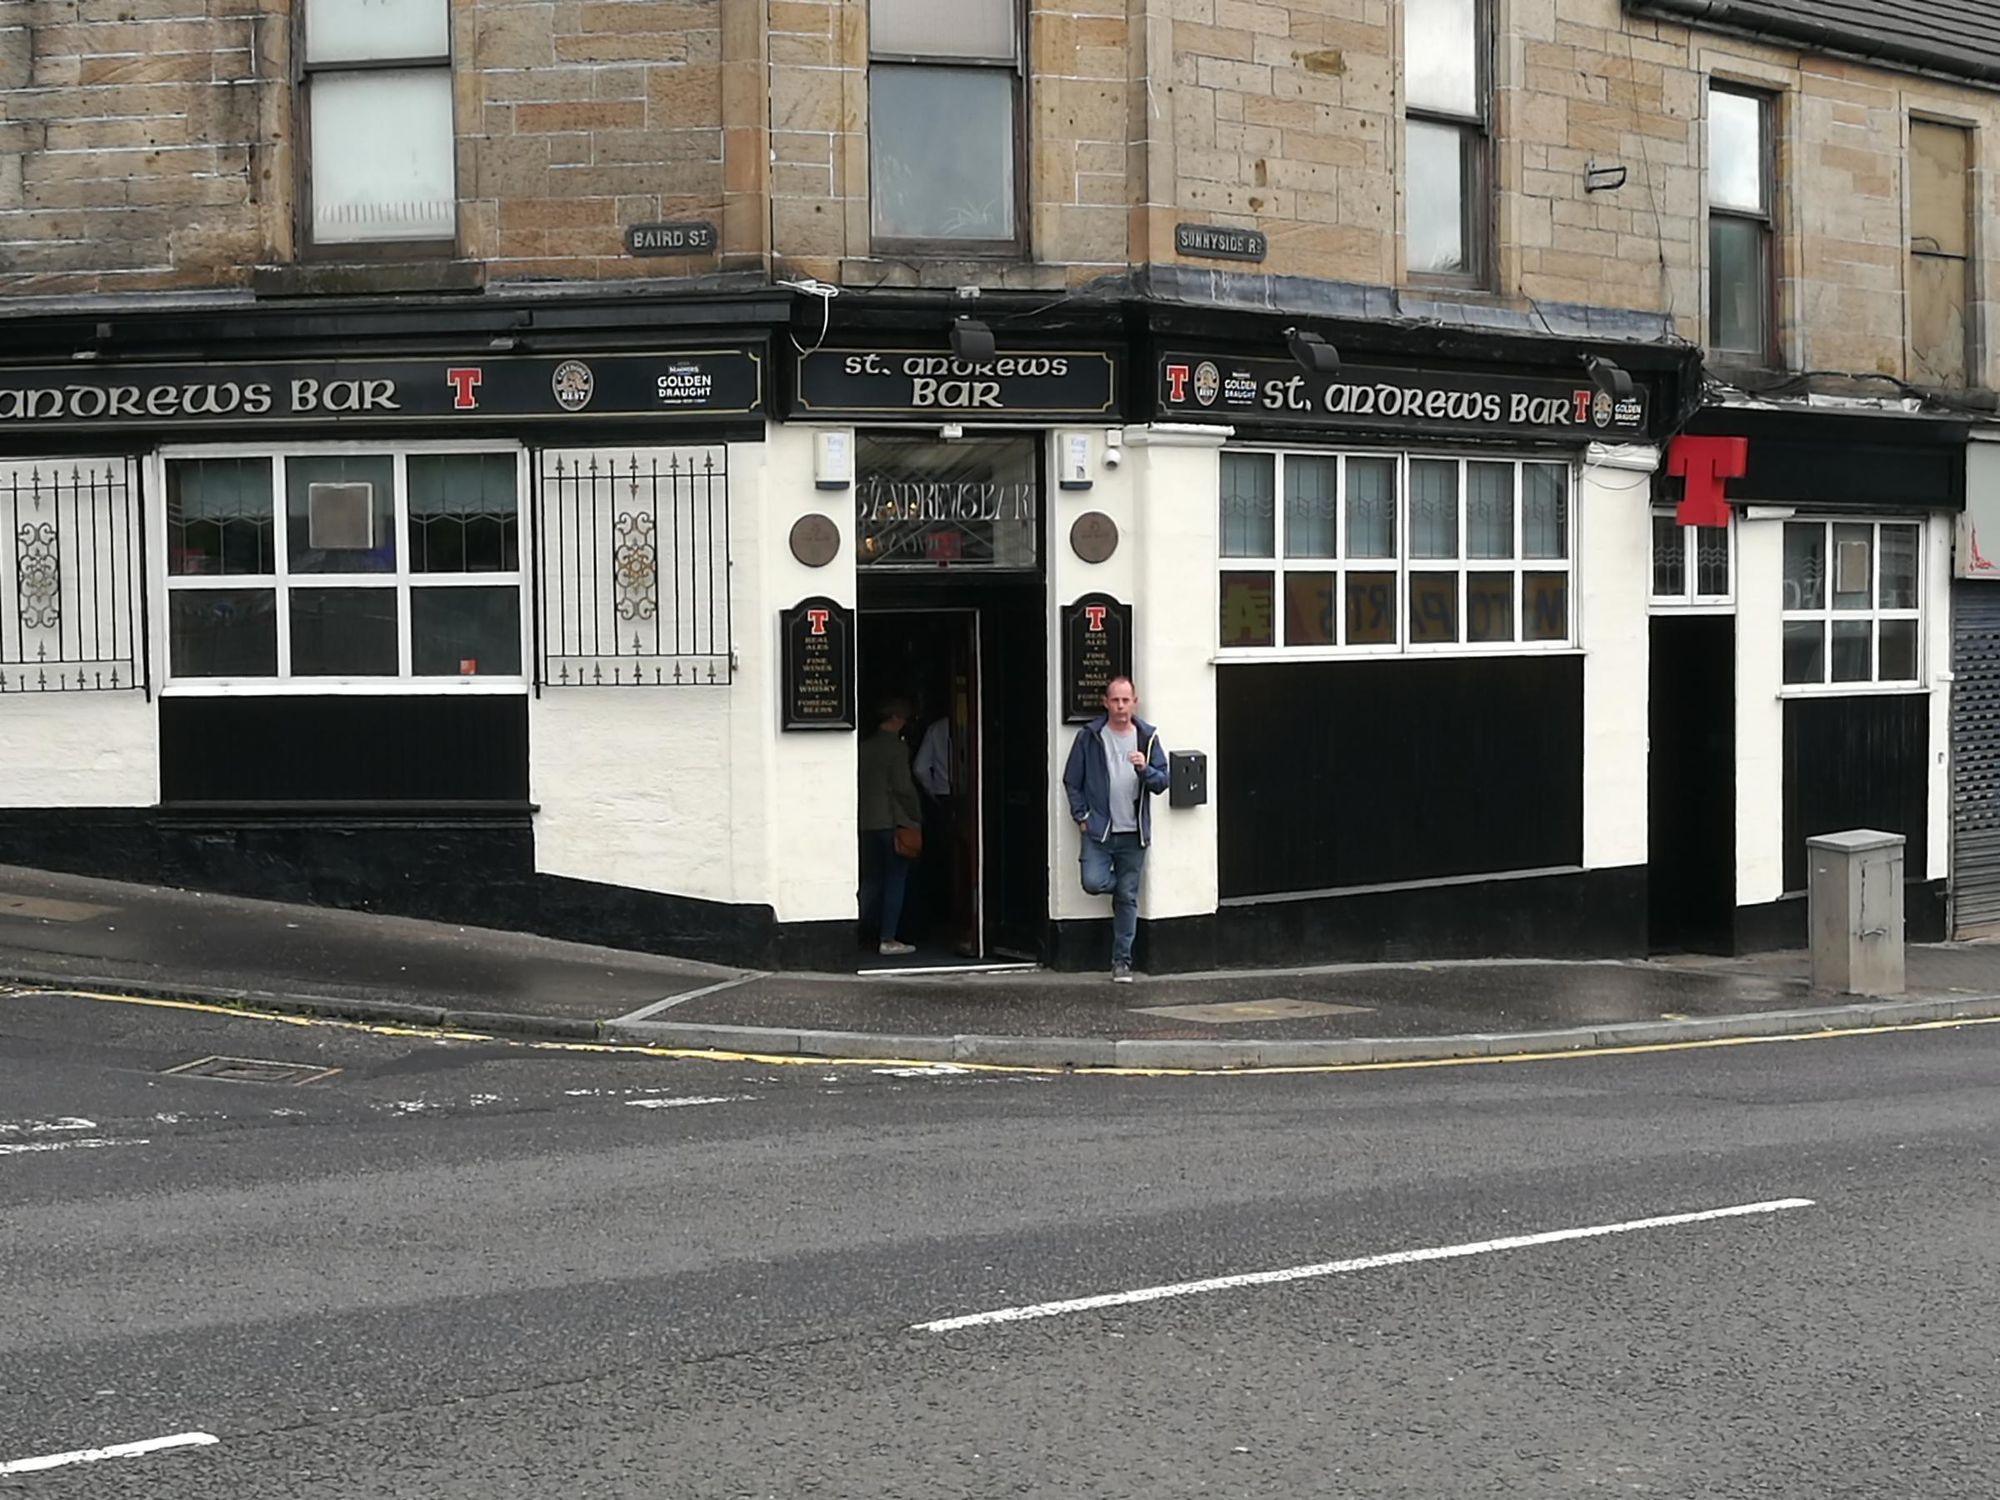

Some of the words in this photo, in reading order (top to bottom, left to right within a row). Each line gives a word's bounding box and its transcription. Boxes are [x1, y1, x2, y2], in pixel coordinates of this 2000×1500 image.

[633, 231, 684, 247] BAIRD
[1181, 231, 1244, 252] SUNNYSIDE
[447, 368, 482, 409] T
[657, 375, 712, 387] GOLDEN
[658, 386, 711, 398] DRAUGHT
[1166, 365, 1189, 403] T
[1573, 390, 1592, 424] T
[1667, 435, 1748, 528] T
[807, 610, 829, 635] T
[1085, 606, 1107, 631] T
[802, 664, 833, 672] WINES
[799, 685, 837, 693] WHISKY
